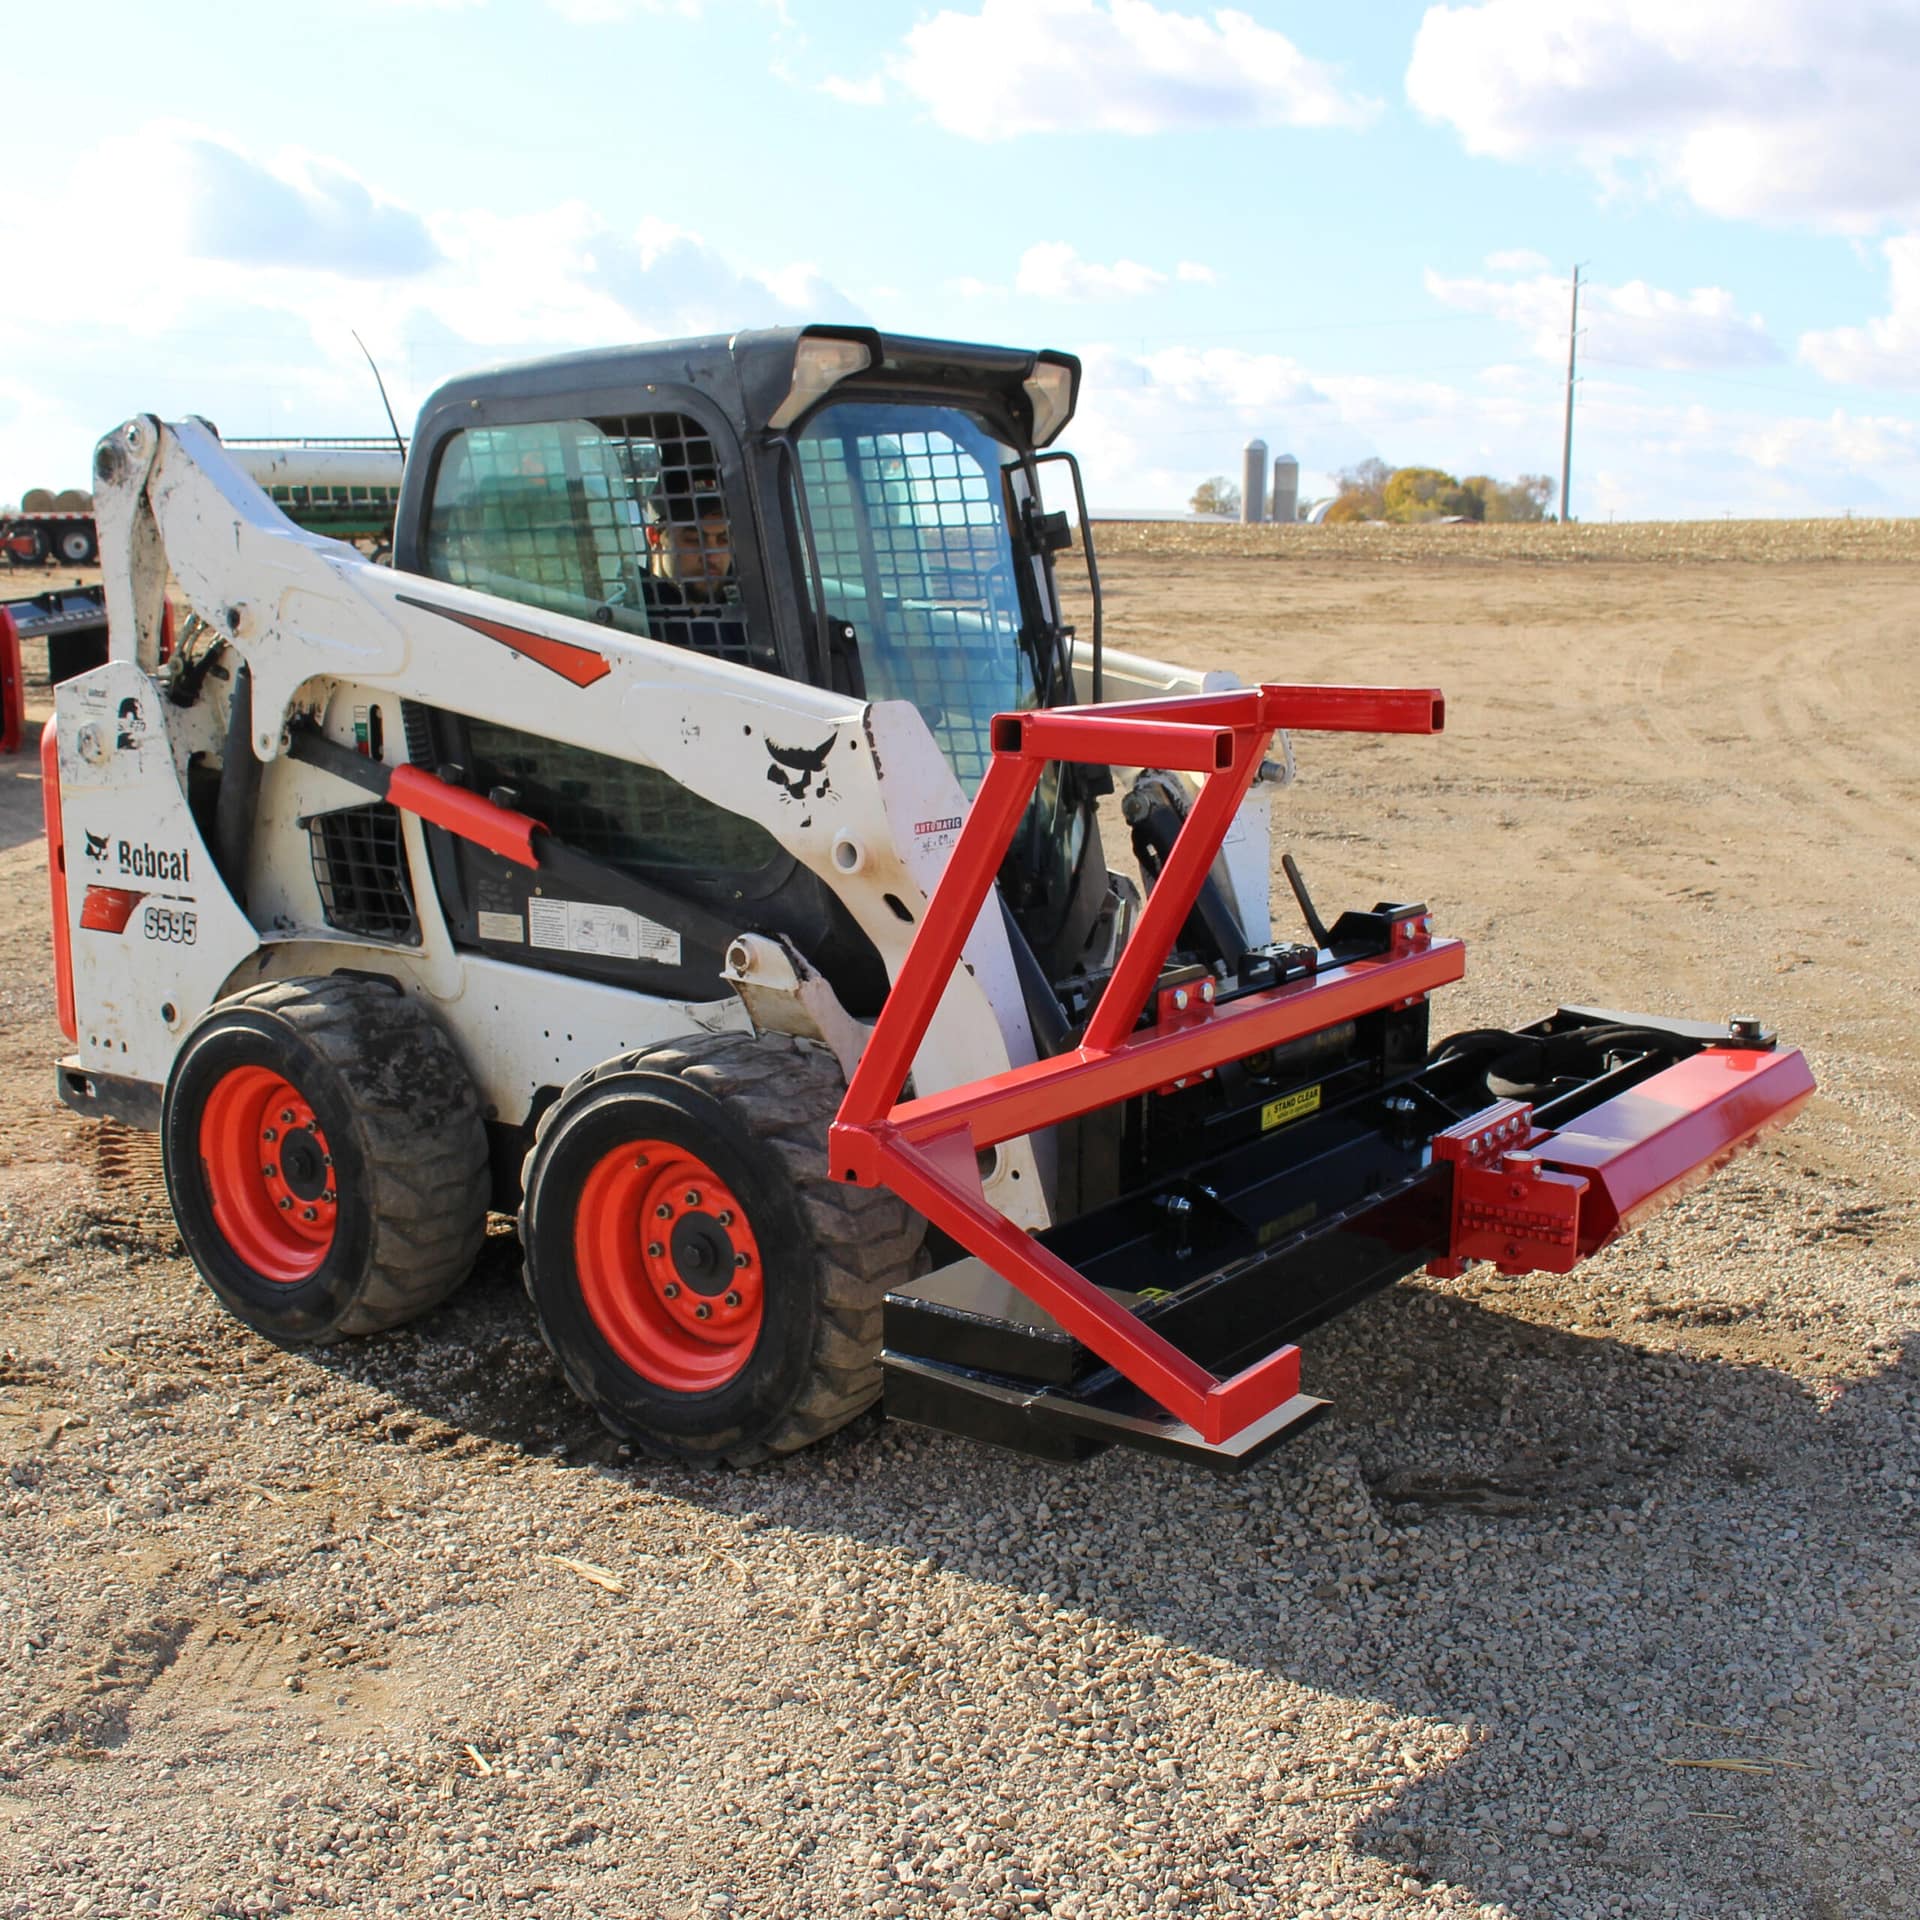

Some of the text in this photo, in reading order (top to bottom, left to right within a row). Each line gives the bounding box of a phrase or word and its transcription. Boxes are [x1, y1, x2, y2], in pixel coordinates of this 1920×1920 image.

[915, 817, 961, 834] AUTOMATIC
[118, 840, 190, 883] Bobcat
[144, 906, 197, 945] S595
[1274, 1097, 1296, 1113] STAND
[1297, 1088, 1318, 1103] CLEAR
